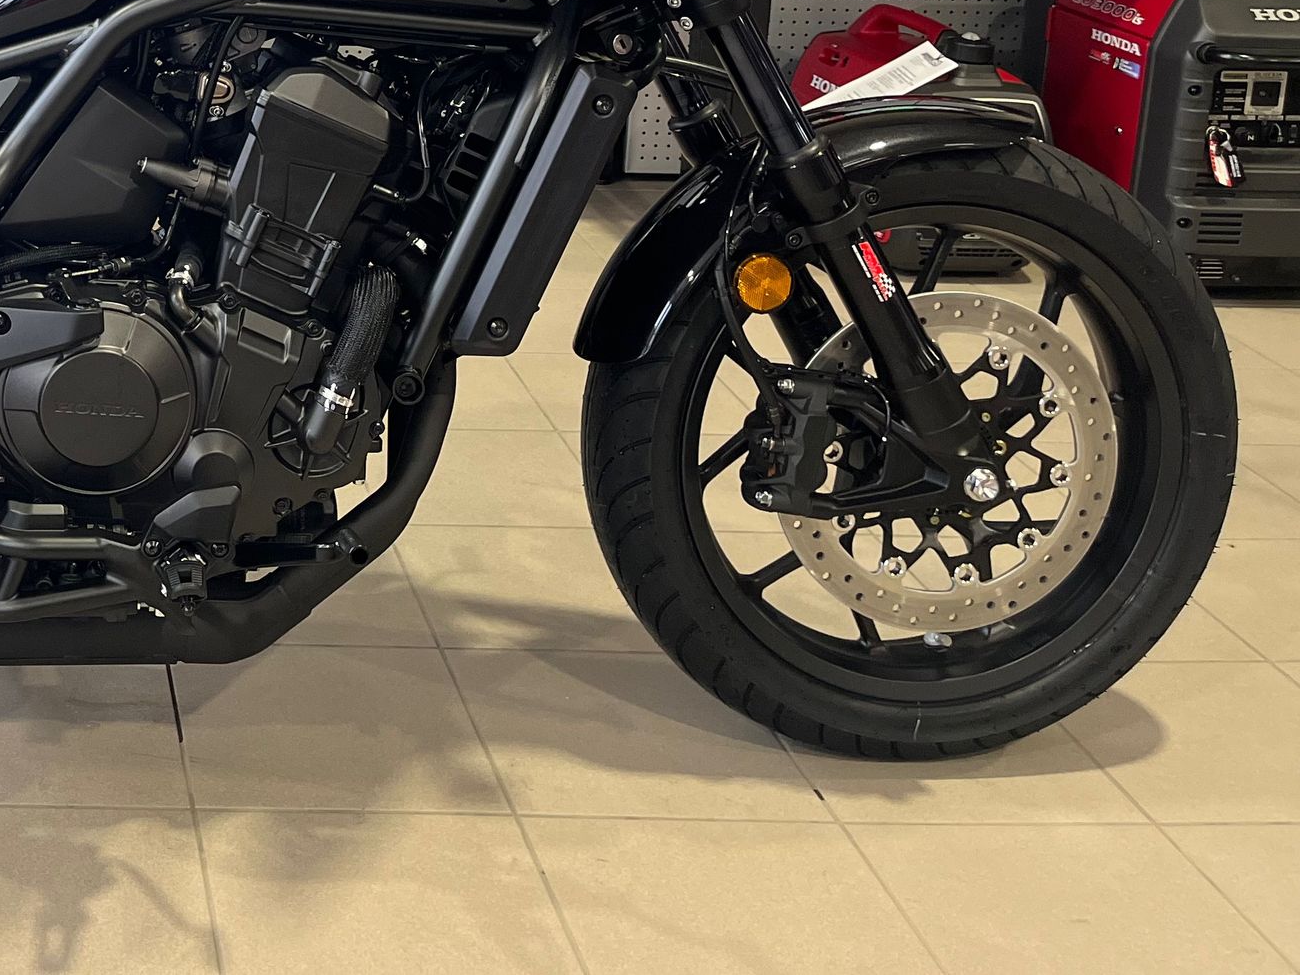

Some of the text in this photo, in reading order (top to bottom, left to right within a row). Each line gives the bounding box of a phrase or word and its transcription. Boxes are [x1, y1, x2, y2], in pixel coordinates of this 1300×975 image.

[1250, 8, 1300, 21] HO
[1091, 28, 1142, 56] HONDA
[54, 401, 145, 418] HONDA
